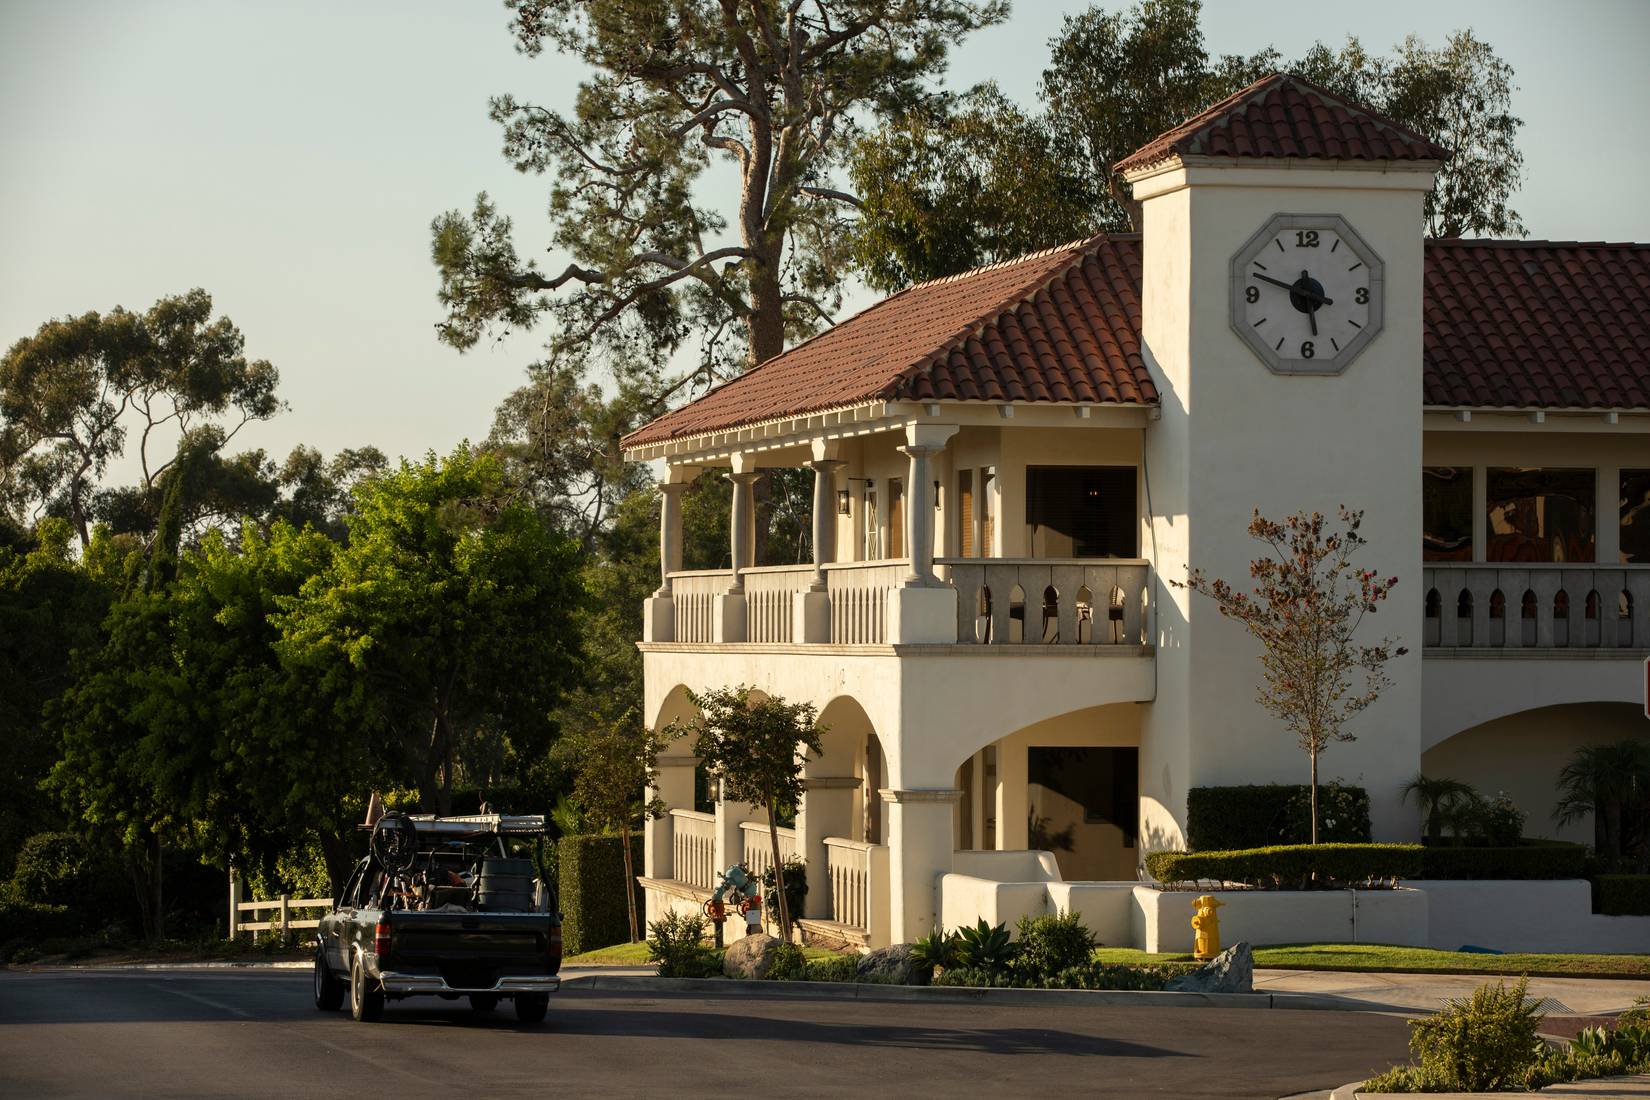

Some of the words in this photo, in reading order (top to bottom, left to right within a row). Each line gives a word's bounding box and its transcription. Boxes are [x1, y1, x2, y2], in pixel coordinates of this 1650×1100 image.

[1296, 231, 1320, 248] 12
[1246, 286, 1260, 303] 9
[1355, 287, 1369, 305] 3
[1300, 341, 1314, 359] 6
